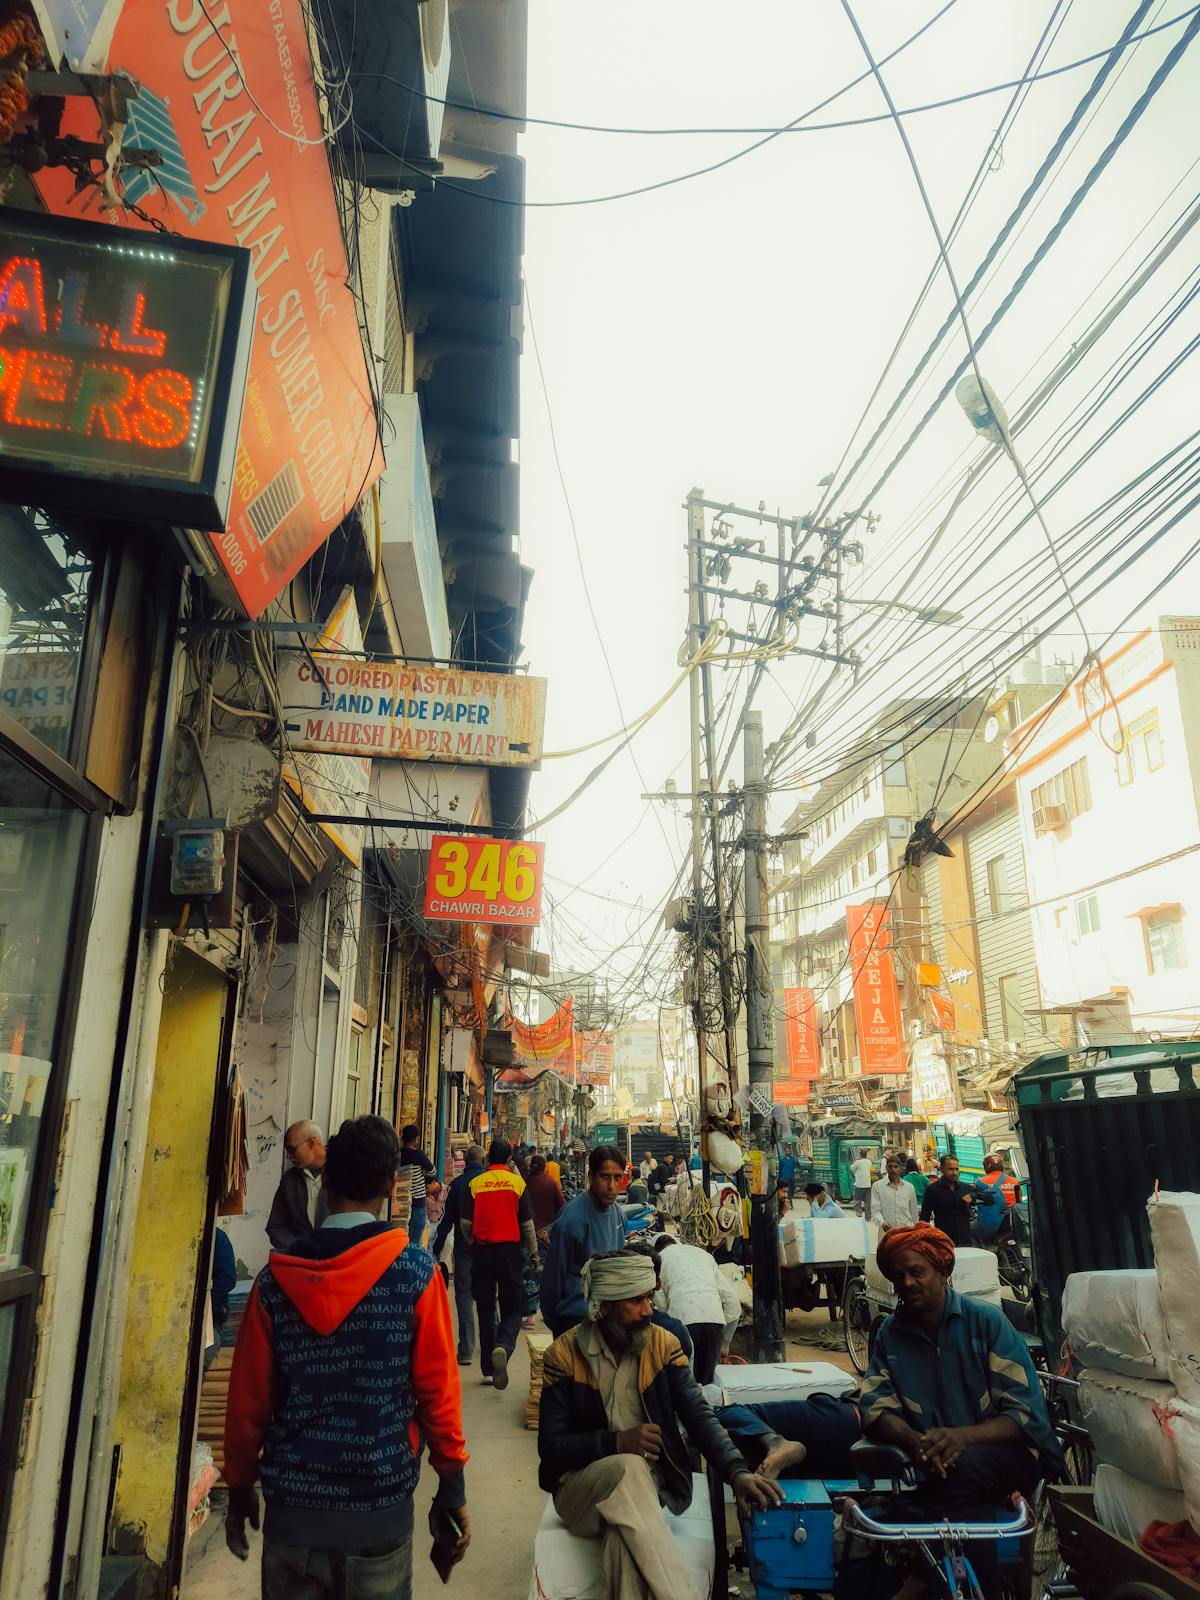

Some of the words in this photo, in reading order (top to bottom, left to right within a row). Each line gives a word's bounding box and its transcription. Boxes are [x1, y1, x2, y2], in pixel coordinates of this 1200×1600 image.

[166, 0, 263, 194] SURAJ
[261, 288, 326, 433] SUMER
[300, 417, 347, 524] CHAND
[297, 664, 394, 690] COLOURED
[399, 670, 467, 697] PASTAL
[321, 692, 375, 715] HAND
[378, 696, 429, 720] MADE
[432, 701, 490, 725] PAPER
[303, 718, 386, 748] MAHESH
[389, 726, 452, 754] PAPER
[456, 731, 509, 757] MART
[435, 841, 537, 902] 346
[429, 900, 485, 915] CHAWRI
[489, 904, 535, 918] BAZAR
[863, 912, 887, 1024] SUNEJA
[356, 1304, 402, 1313] ARMANI
[370, 1320, 407, 1330] JEANS
